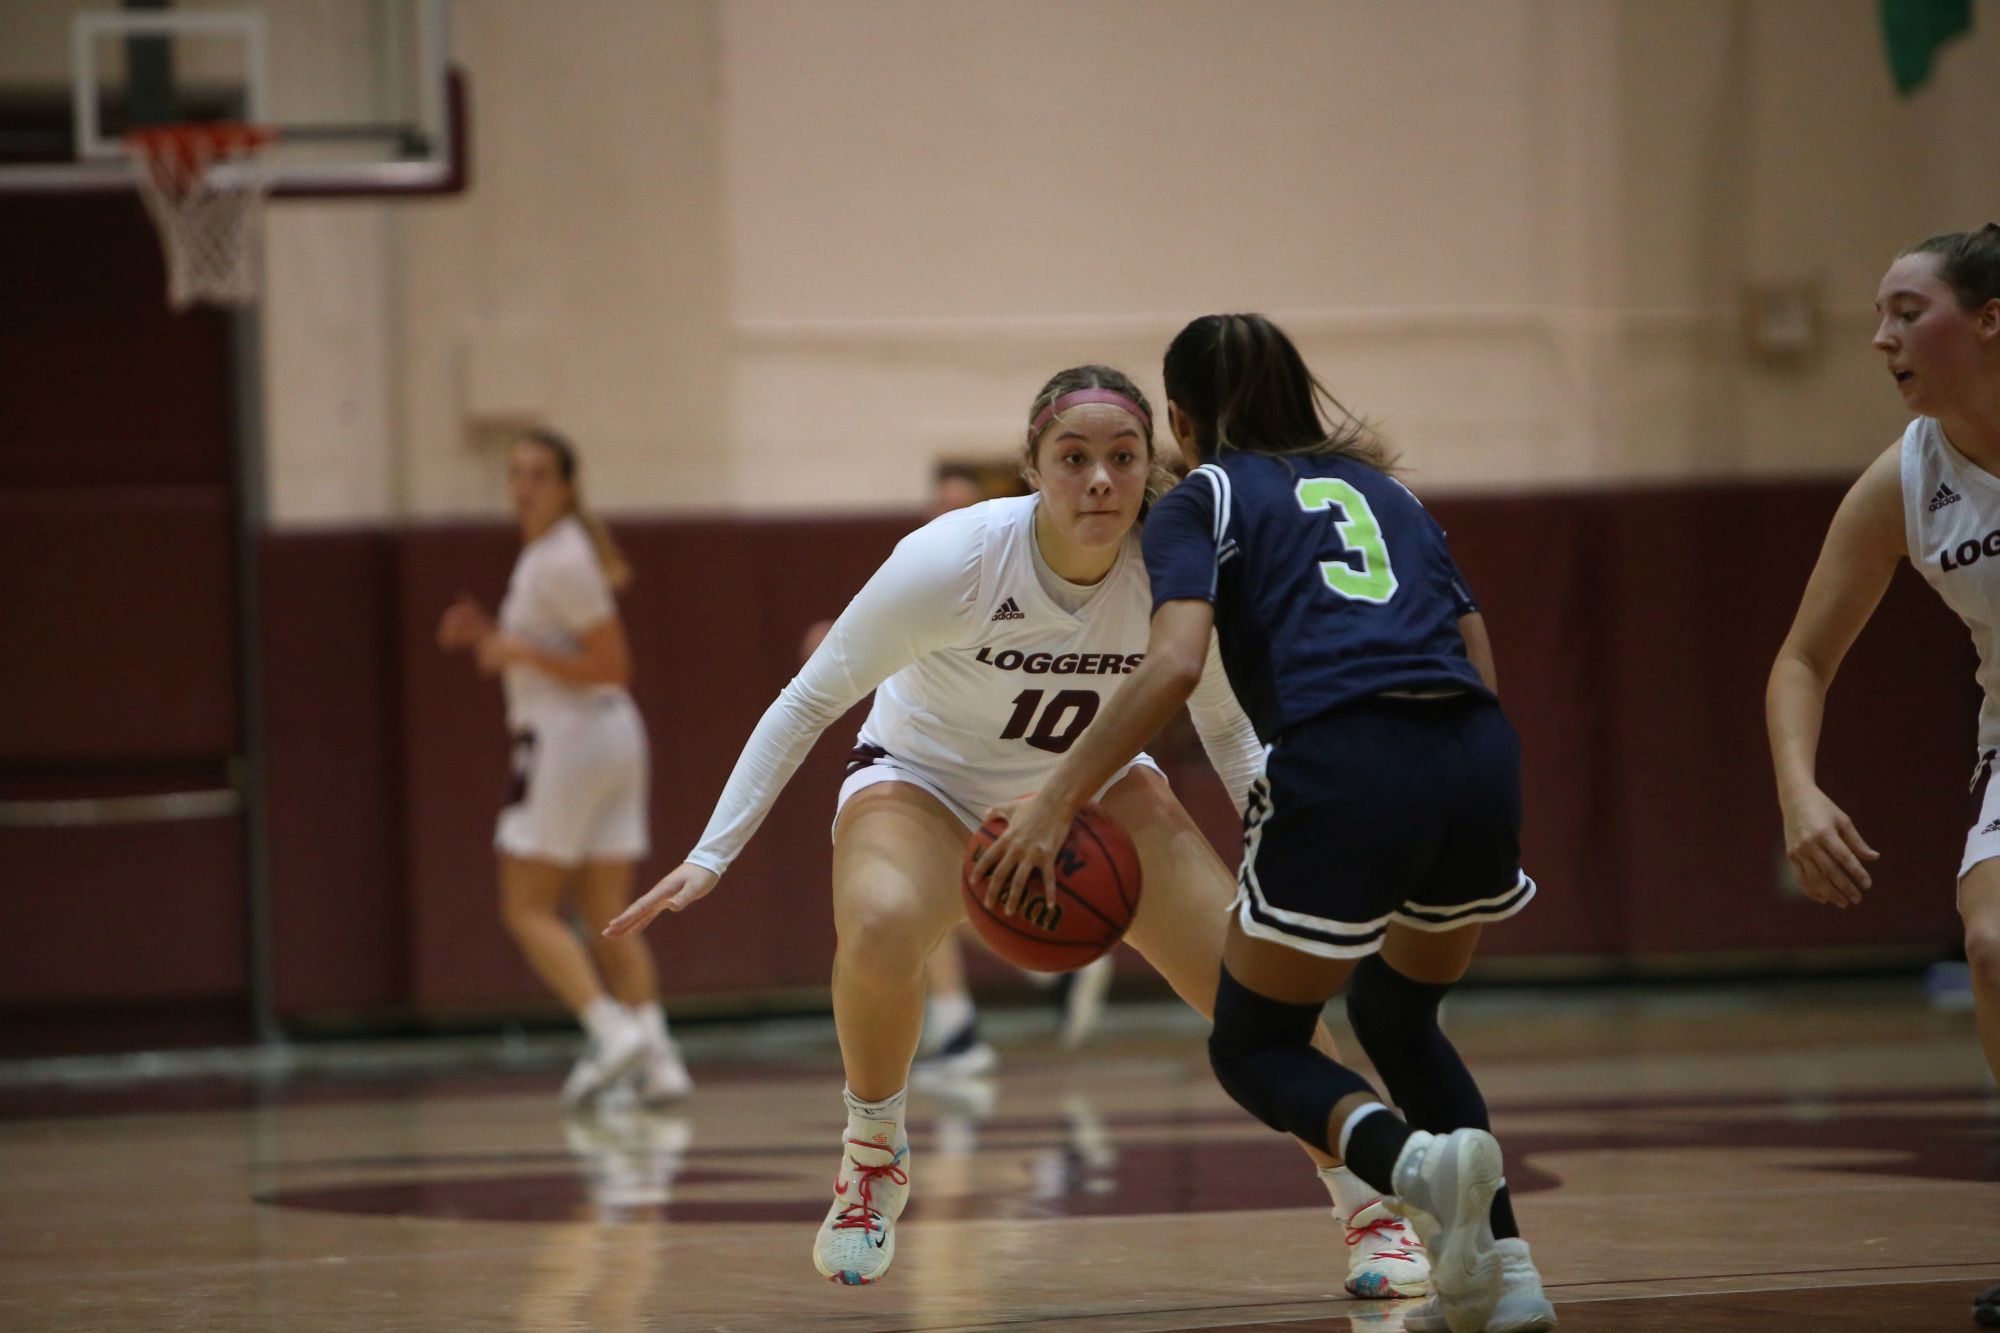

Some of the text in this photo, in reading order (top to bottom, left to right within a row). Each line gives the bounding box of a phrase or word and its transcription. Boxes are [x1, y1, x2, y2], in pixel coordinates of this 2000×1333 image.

[1295, 477, 1399, 605] 3
[991, 611, 1025, 621] adidas
[975, 647, 1146, 675] LOGGERS
[998, 689, 1101, 754] 10
